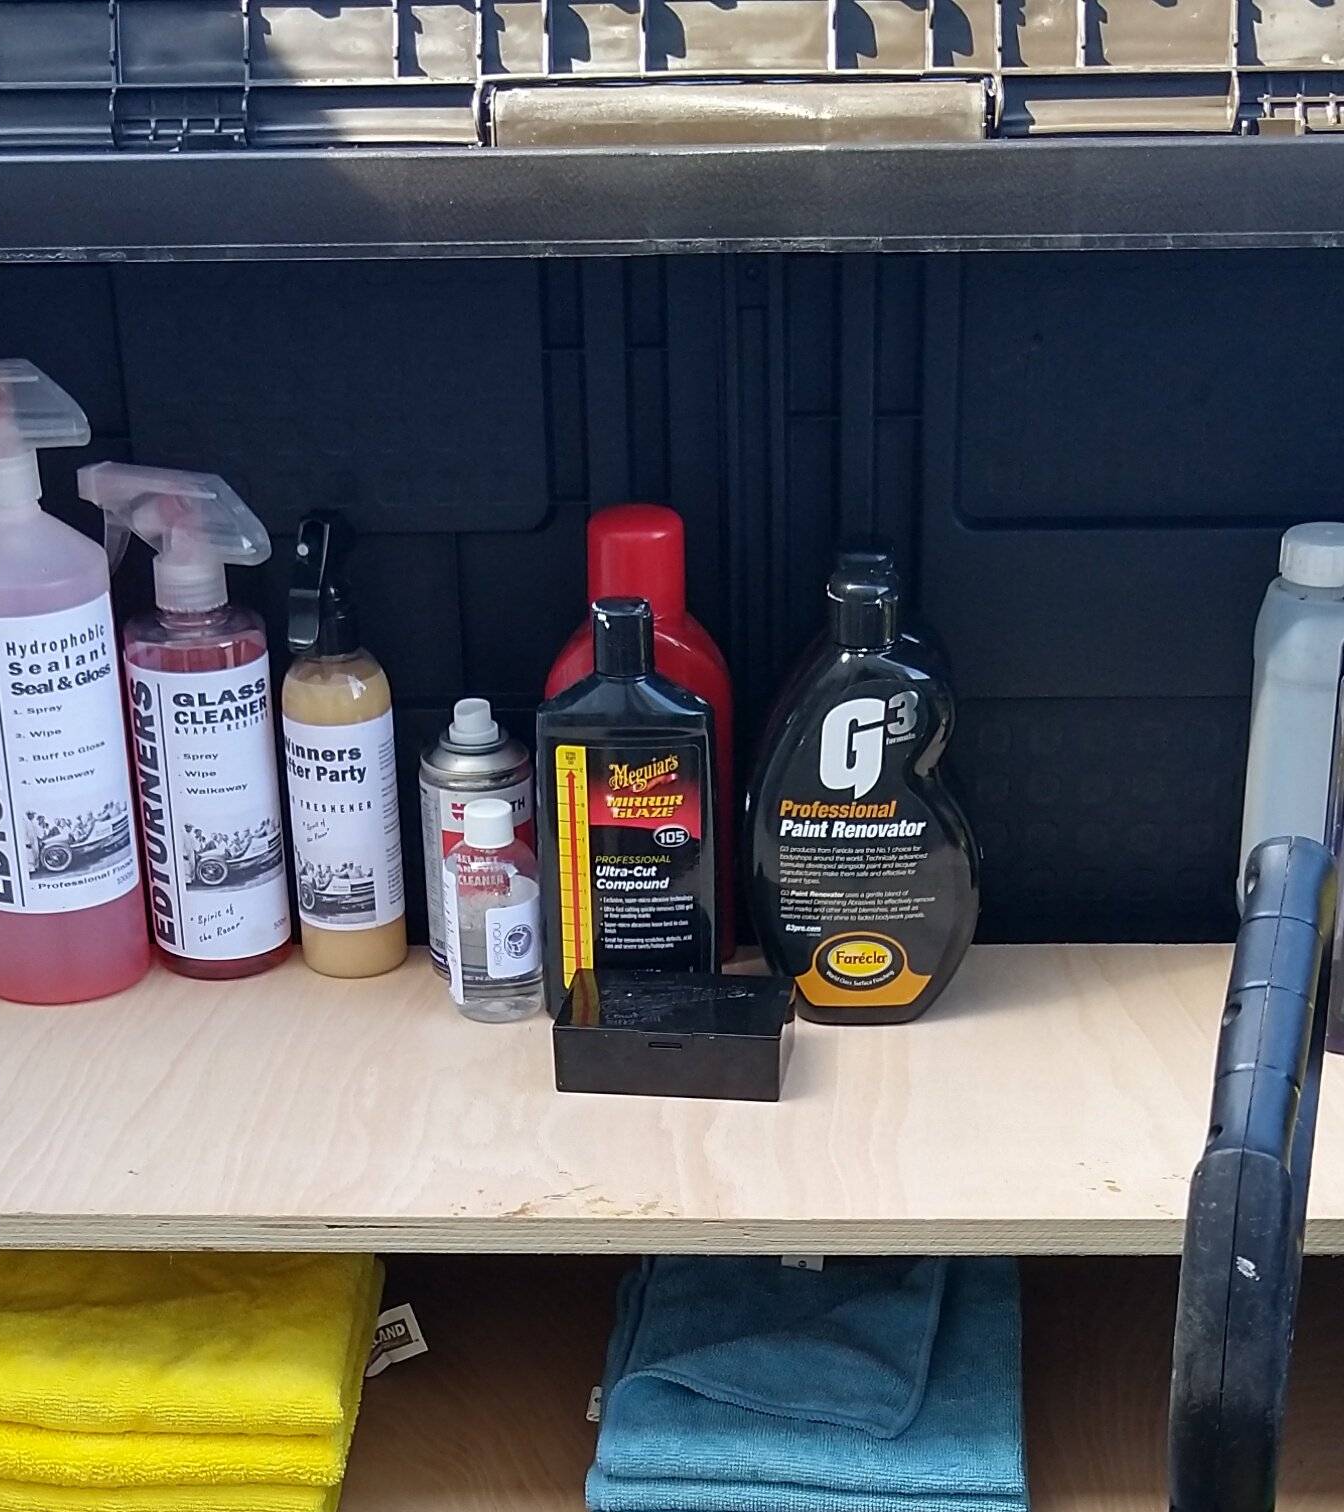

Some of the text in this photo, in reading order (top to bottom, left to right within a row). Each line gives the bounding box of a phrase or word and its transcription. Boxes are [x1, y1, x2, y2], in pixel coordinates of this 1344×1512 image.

[6, 624, 105, 659] Hydrophobic
[8, 642, 107, 676] Sealant
[10, 663, 112, 696] Seal & Gloss
[172, 677, 266, 708] GLASS
[27, 704, 63, 716] Spray
[174, 695, 268, 725] CLEANER
[29, 728, 62, 738] Wipe
[32, 752, 60, 762] Buff
[62, 749, 75, 758] to
[77, 741, 106, 754] Gloss
[183, 753, 219, 761] Spray
[35, 768, 96, 785] Walkaway
[184, 770, 217, 778] Wipe
[287, 756, 367, 784] fter Party
[608, 754, 679, 793] Meguiar's
[186, 783, 248, 795] Walkaway
[606, 794, 684, 807] MIRROR
[130, 677, 177, 947] EDTURNERS
[612, 806, 675, 819] GLAZE
[779, 799, 897, 819] Professional
[658, 830, 685, 844] 105
[779, 819, 927, 839] Paint Renovator
[595, 855, 672, 864] PROFESSIONAL
[596, 865, 658, 878] Ultra-Cut
[38, 870, 110, 890] Professional
[458, 875, 505, 886] CLEANER
[596, 877, 670, 892] Compound
[836, 950, 887, 965] Farécla
